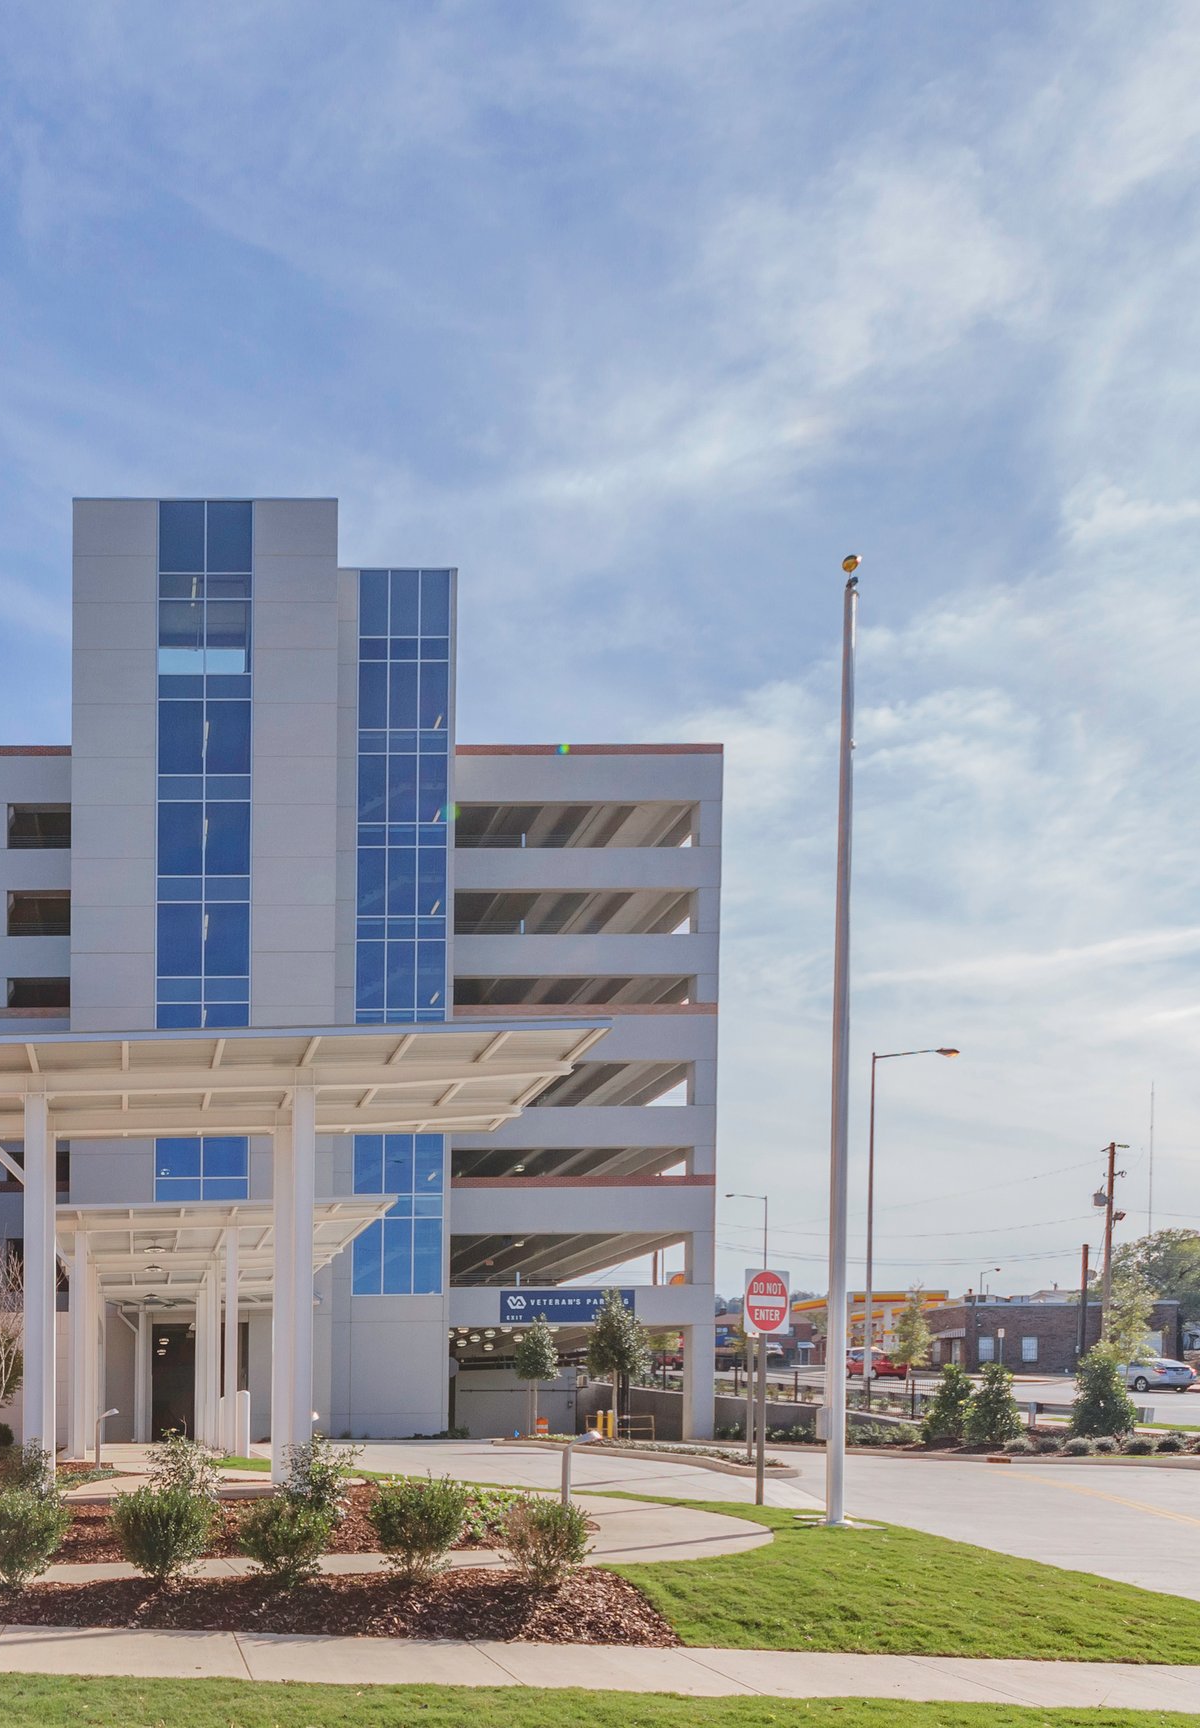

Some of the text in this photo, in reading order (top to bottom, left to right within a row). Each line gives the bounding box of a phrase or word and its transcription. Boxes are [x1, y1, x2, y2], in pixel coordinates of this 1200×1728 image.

[753, 1281, 783, 1295] DO NOT
[530, 1298, 581, 1306] VETERAN'S
[586, 1298, 629, 1306] PARG
[754, 1308, 781, 1321] ENTER
